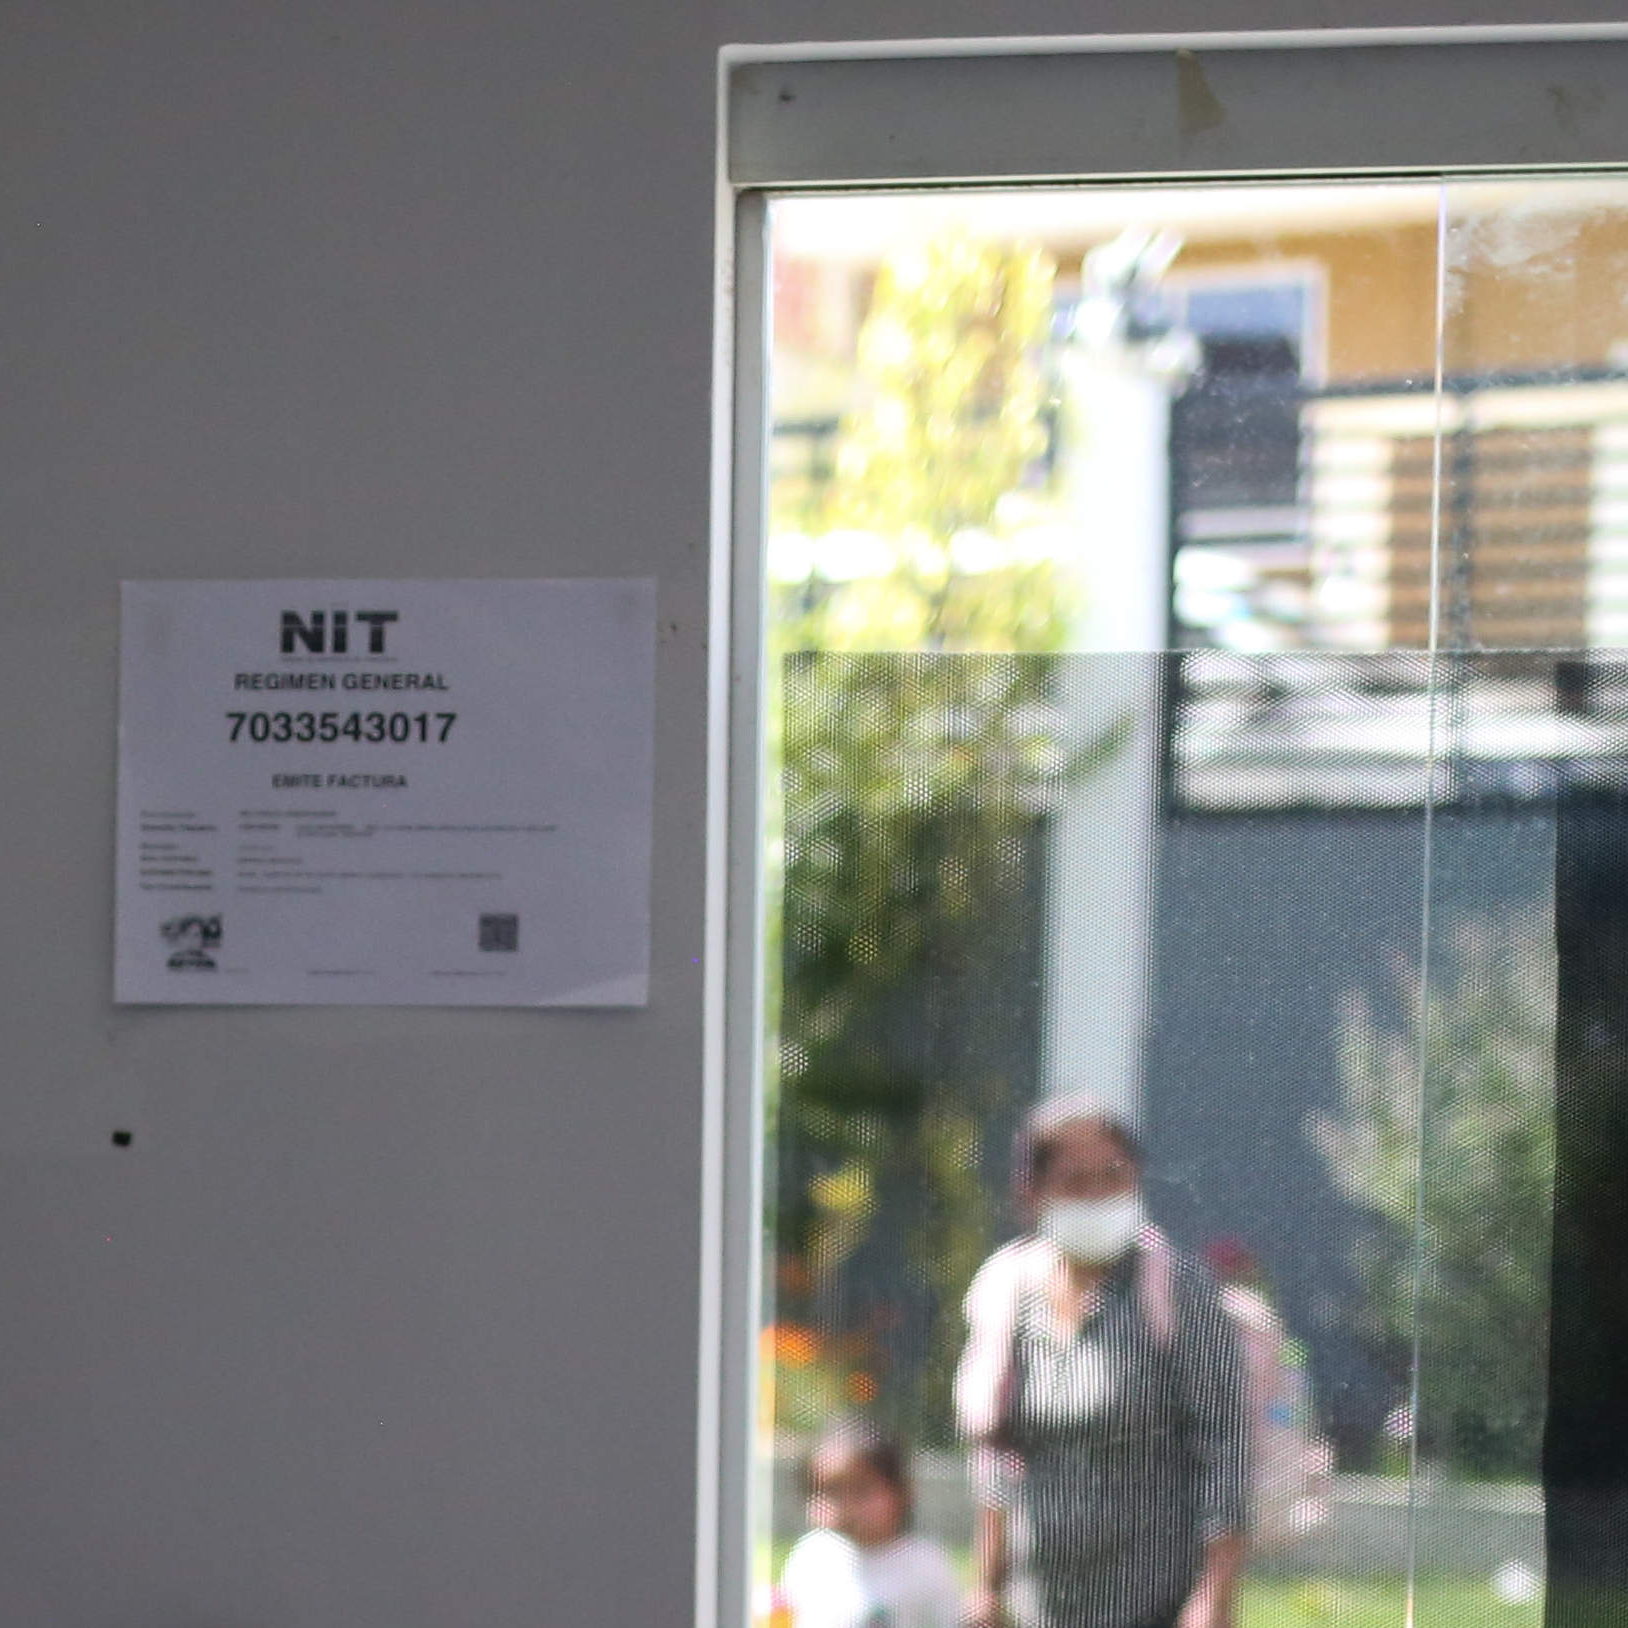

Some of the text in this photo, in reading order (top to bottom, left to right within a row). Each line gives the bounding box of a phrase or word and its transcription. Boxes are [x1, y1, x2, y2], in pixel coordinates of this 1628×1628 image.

[280, 610, 399, 654] NIT
[234, 672, 450, 690] REGIMEN GENERAL
[225, 711, 458, 743] 7033543017
[272, 774, 408, 789] EMITE FACTURA
